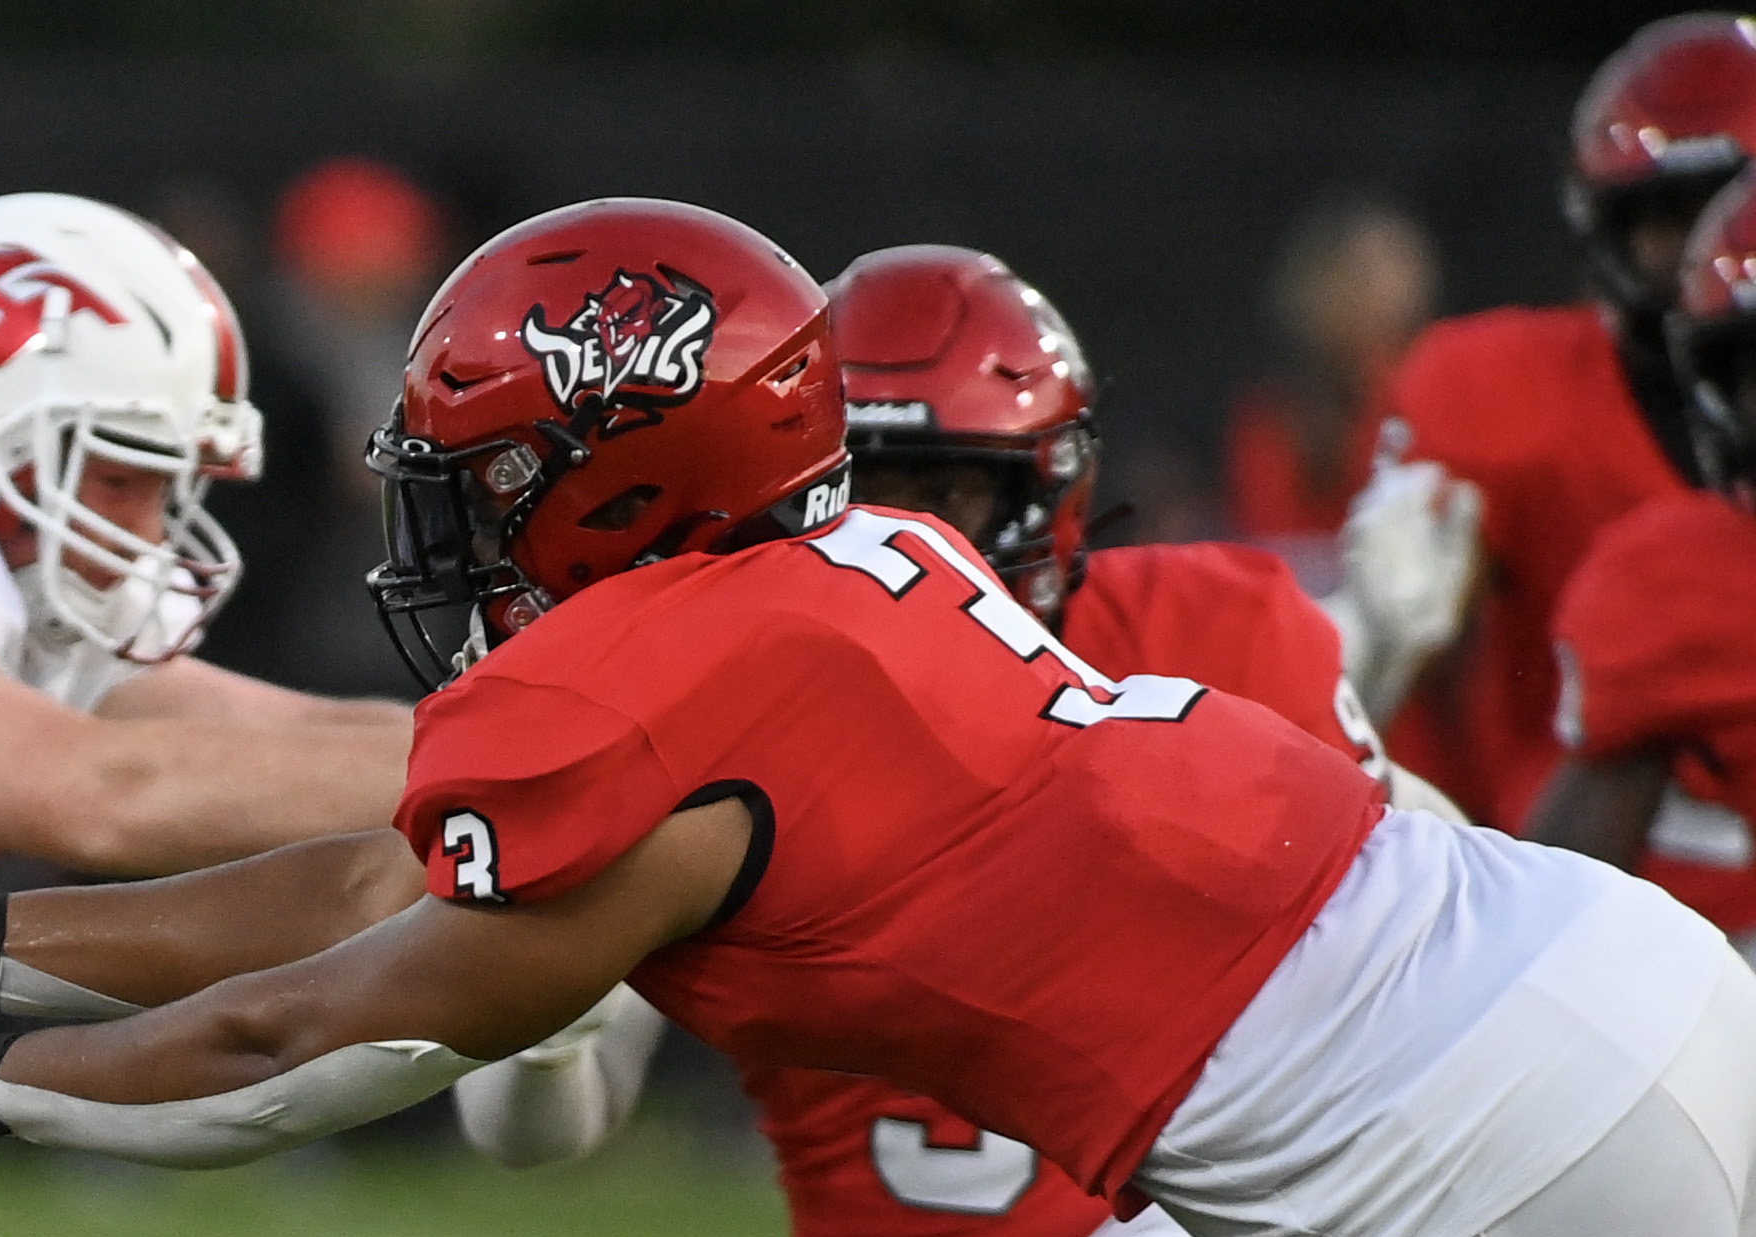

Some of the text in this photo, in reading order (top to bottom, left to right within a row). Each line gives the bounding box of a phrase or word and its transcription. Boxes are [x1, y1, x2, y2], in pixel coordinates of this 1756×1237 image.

[525, 303, 711, 404] DEVILS
[806, 508, 1210, 728] 3
[442, 808, 500, 901] 3
